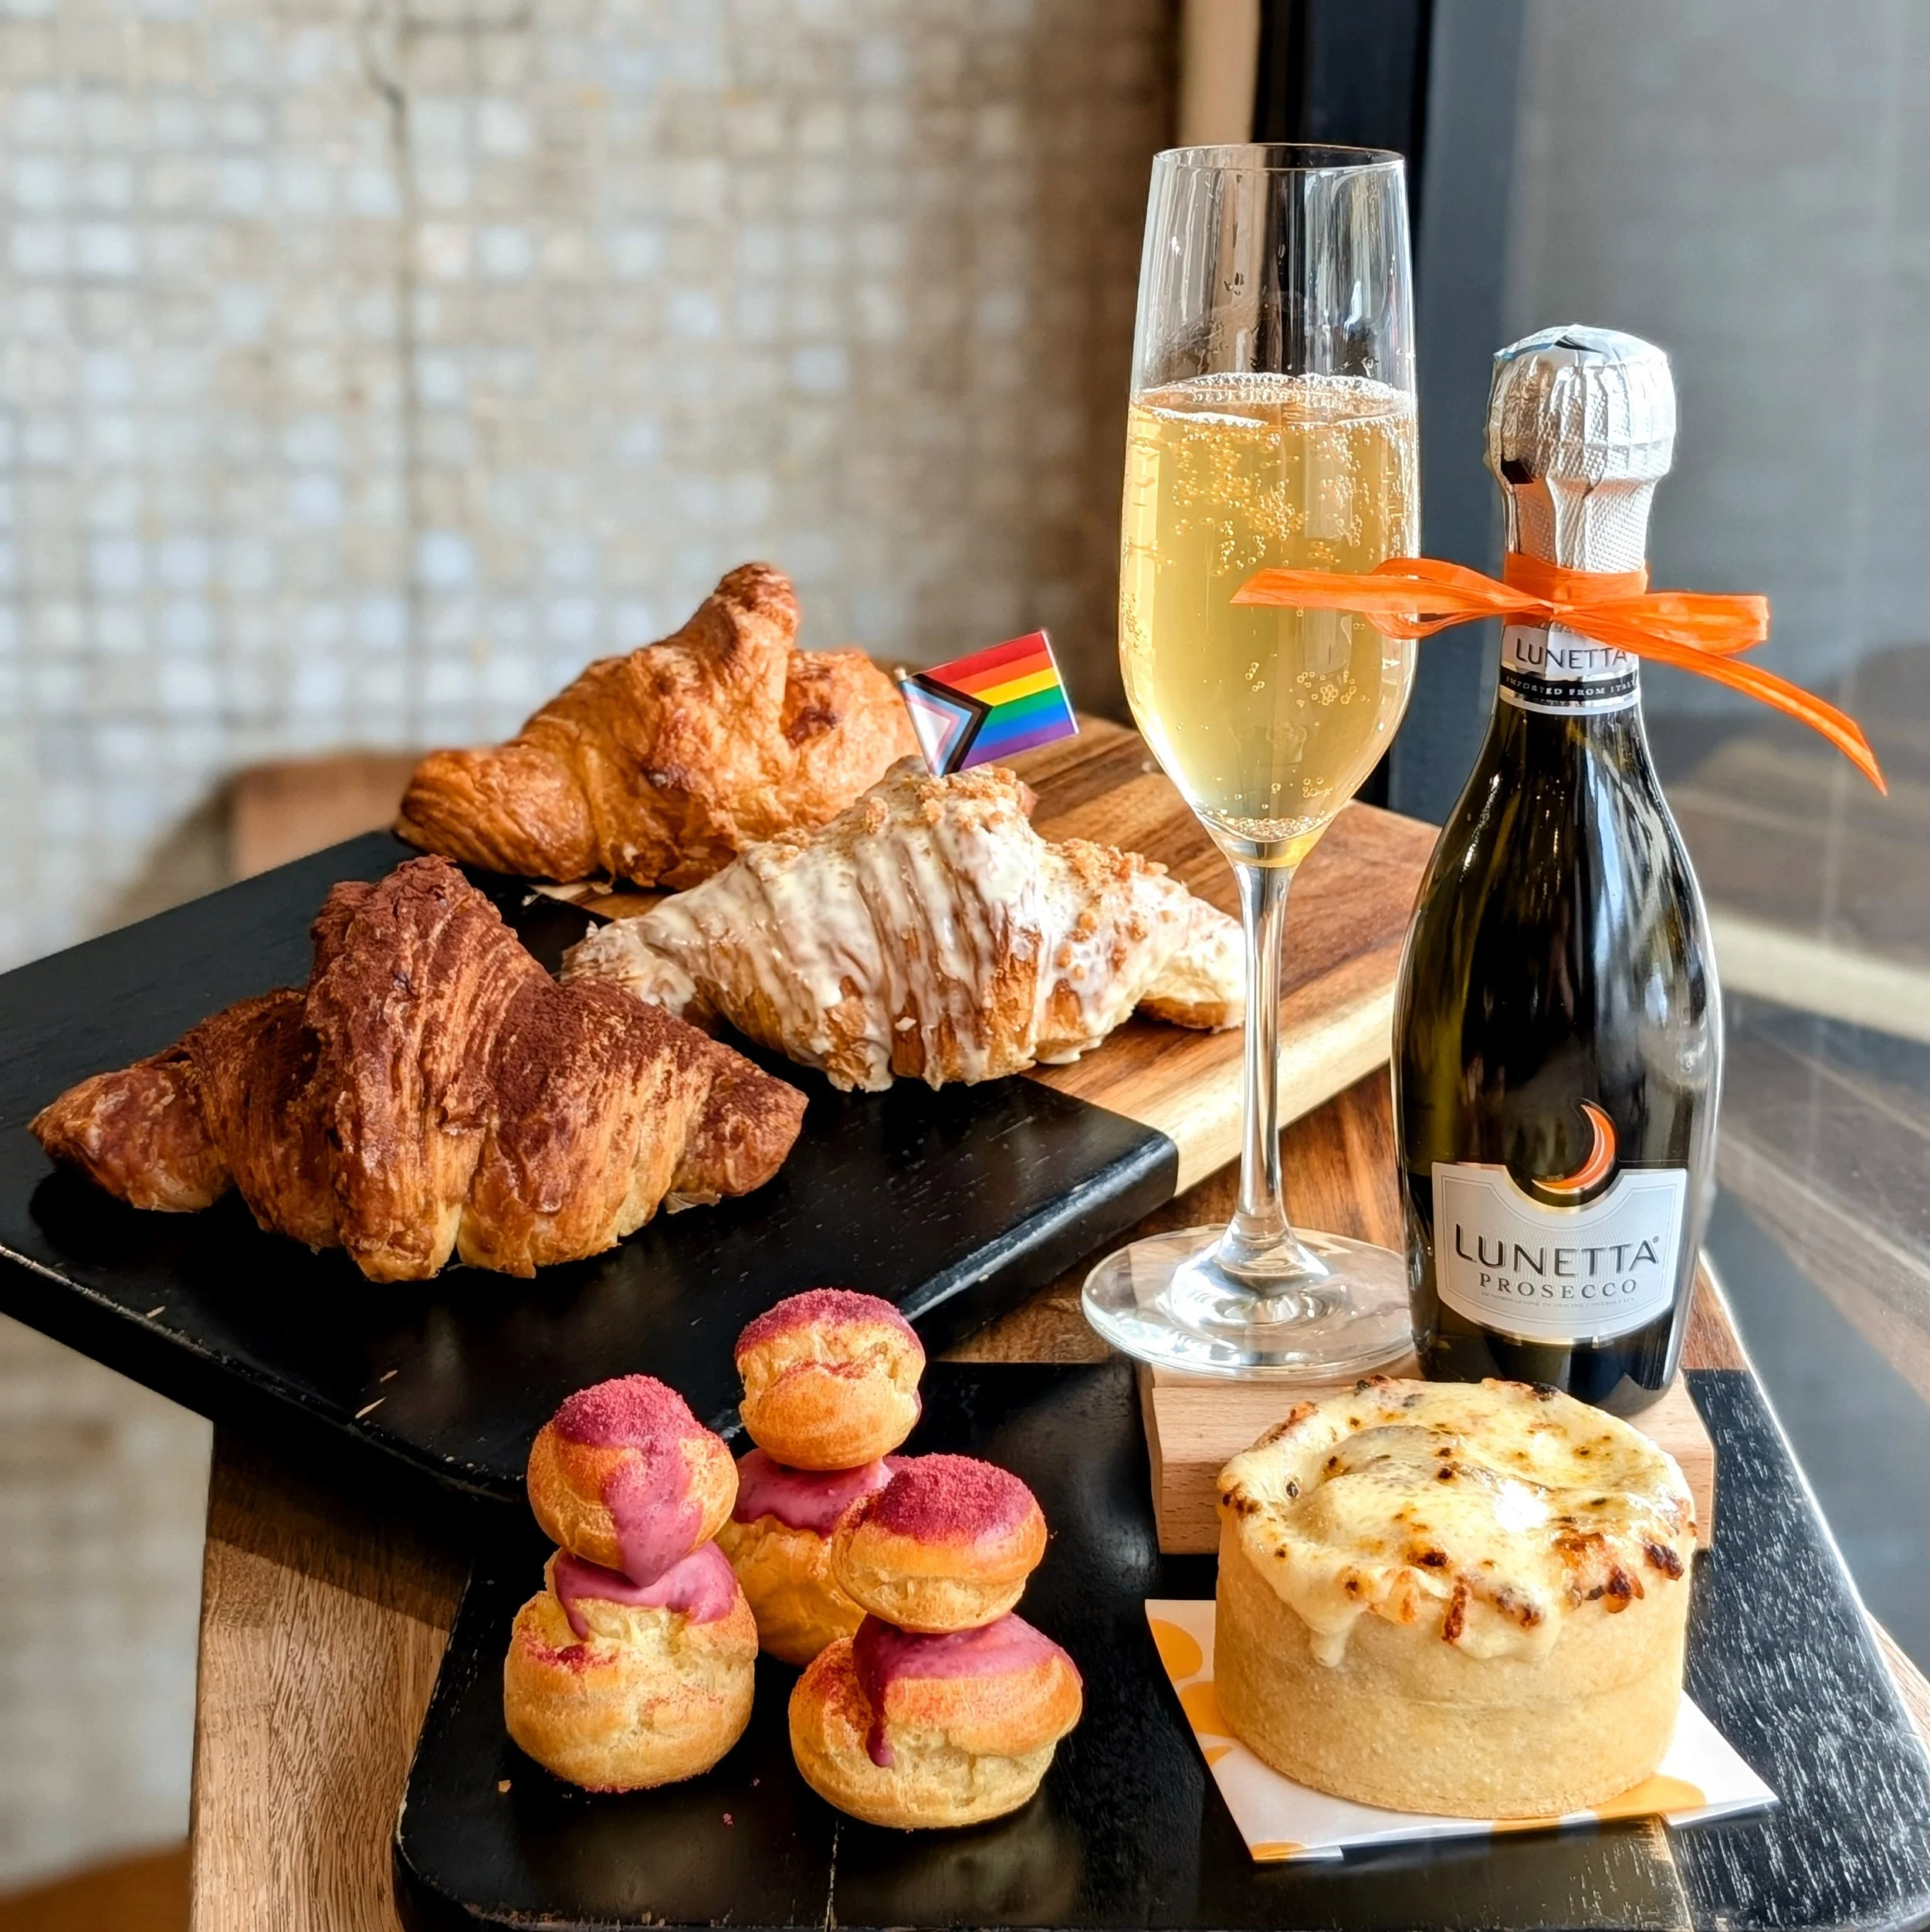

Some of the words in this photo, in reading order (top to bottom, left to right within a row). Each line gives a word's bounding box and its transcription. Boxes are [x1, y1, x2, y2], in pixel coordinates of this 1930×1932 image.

[1515, 638, 1627, 669] LUNETTA
[1569, 686, 1606, 697] FROM
[1455, 1223, 1659, 1277] LUNETTA
[1479, 1273, 1637, 1300] PROSECCO
